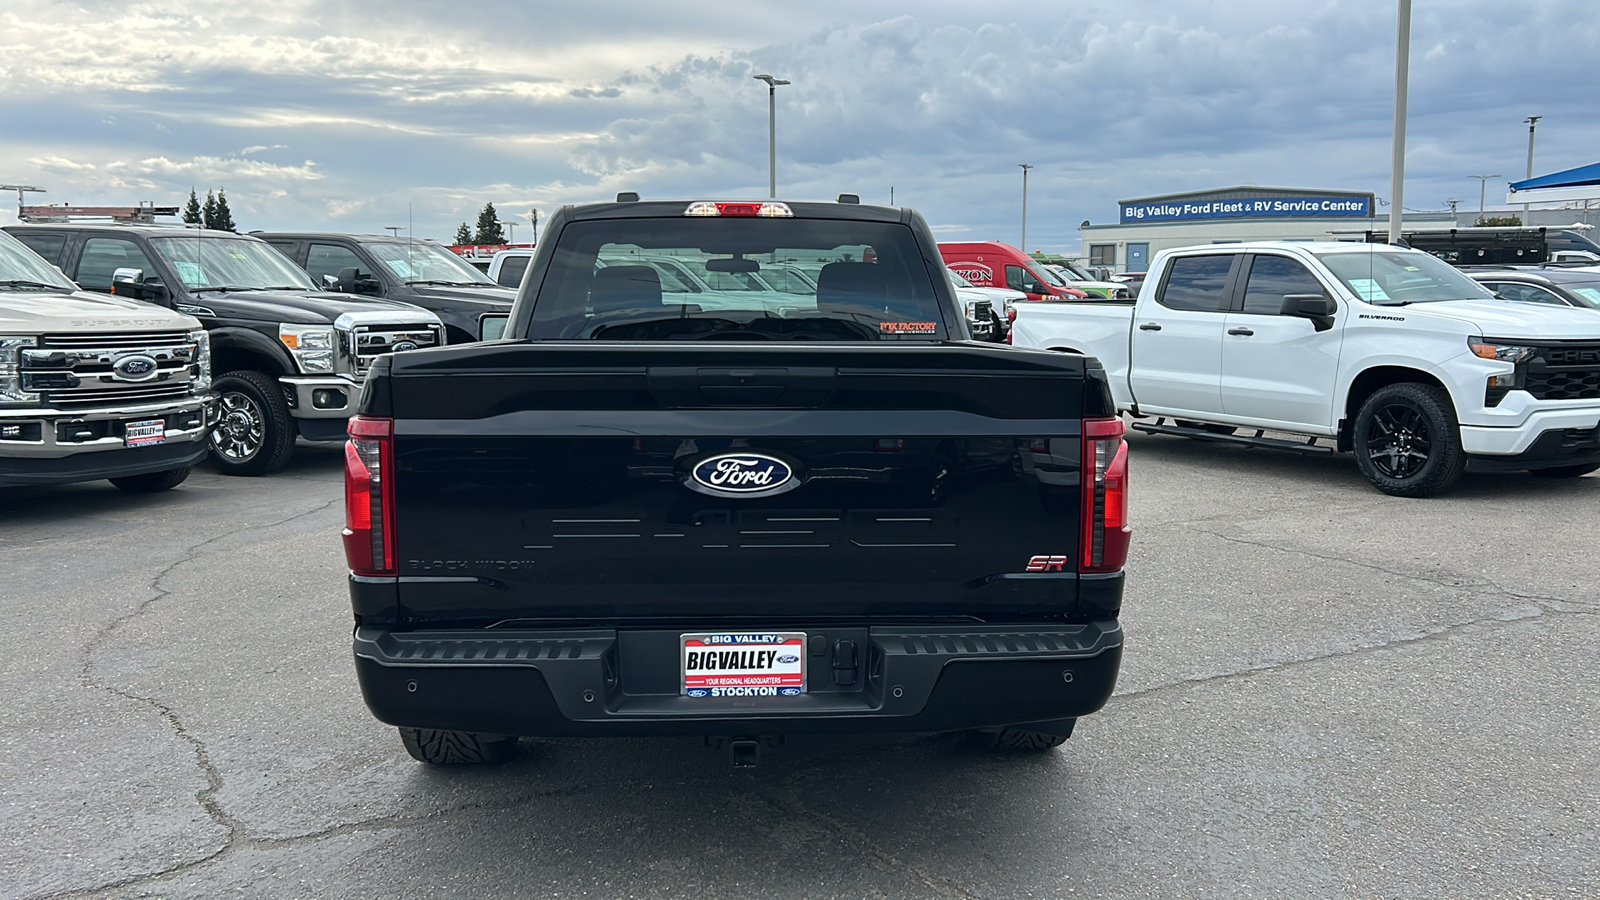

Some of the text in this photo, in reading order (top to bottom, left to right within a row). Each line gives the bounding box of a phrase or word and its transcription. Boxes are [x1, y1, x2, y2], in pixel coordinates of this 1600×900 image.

[1125, 200, 1363, 219] Big Valley Ford Fleet & RV Service Center
[1358, 314, 1406, 322] SILVERADO
[880, 322, 937, 330] FOX FACTORY
[127, 361, 148, 373] Ford
[710, 459, 774, 485] Ford
[409, 559, 536, 570] BLACK WIDOW
[1025, 555, 1067, 571] SR
[711, 634, 776, 644] BIG VALLEY
[706, 678, 719, 686] YOUR
[744, 677, 782, 685] HEADQUARTERS
[711, 687, 777, 697] STOCKTON
